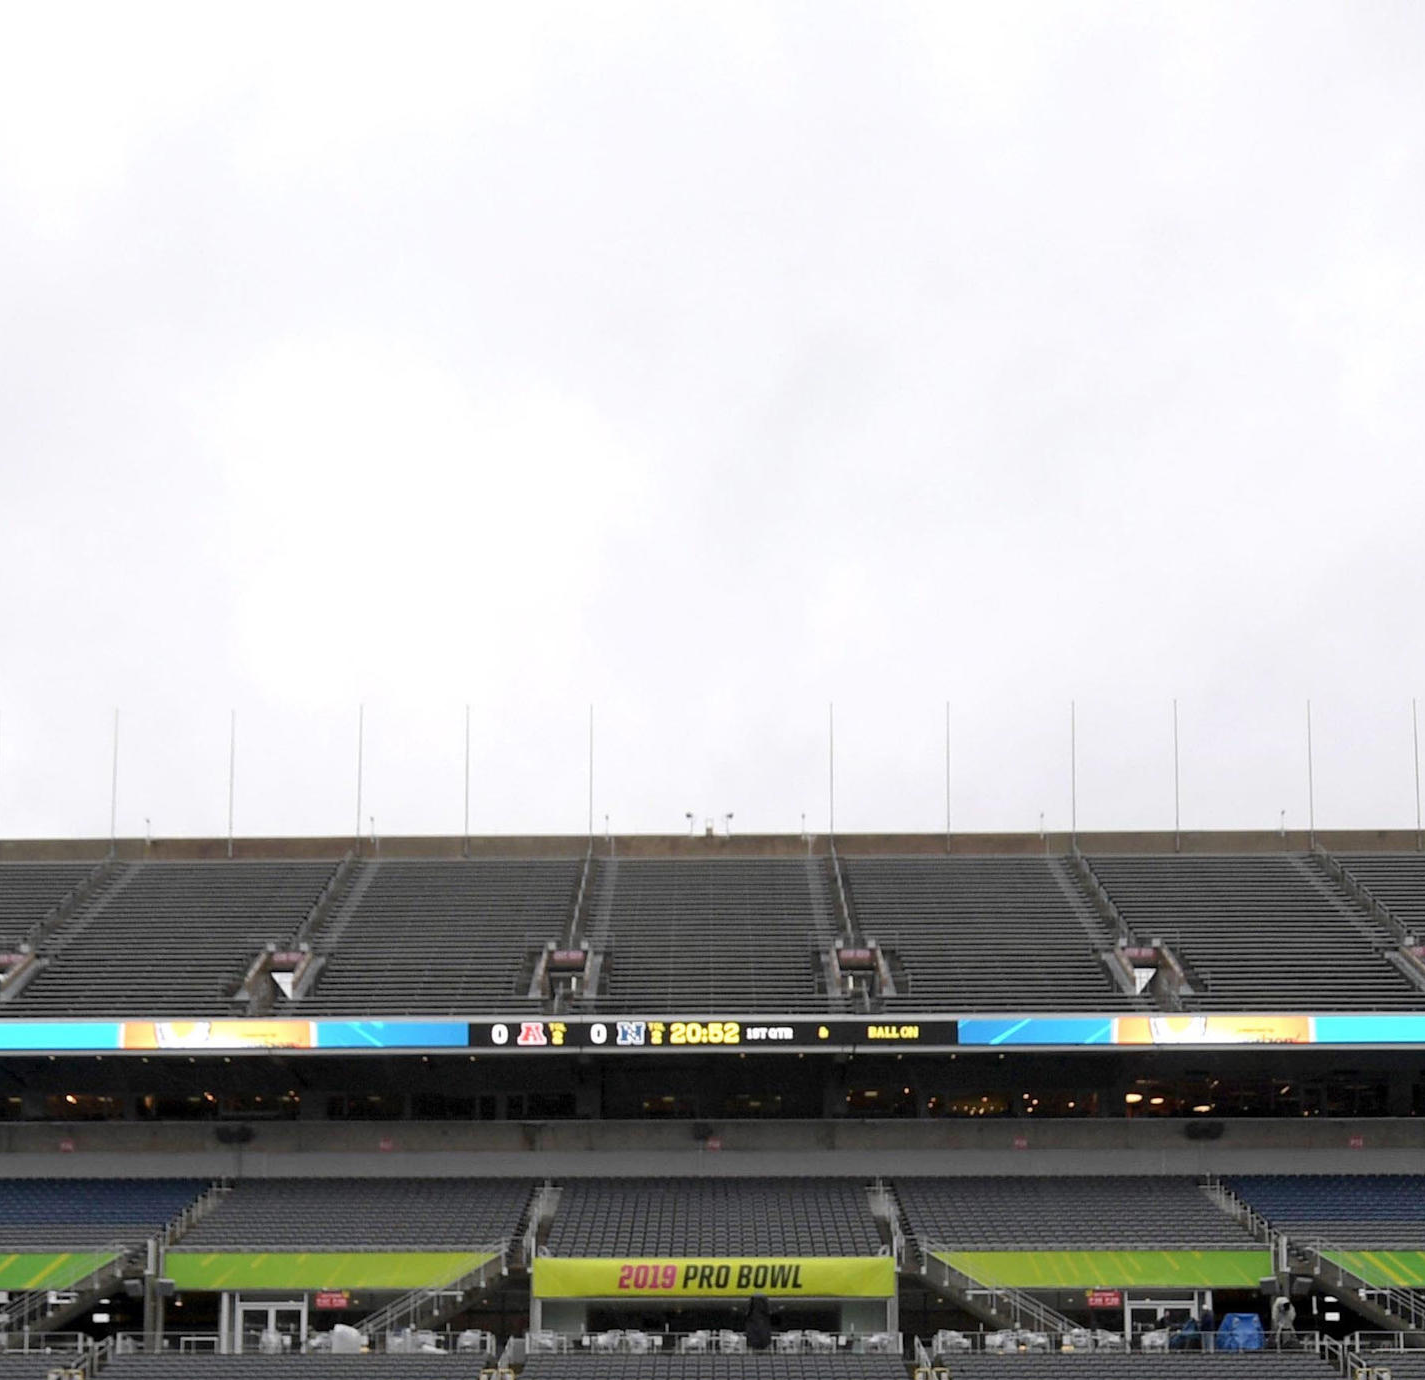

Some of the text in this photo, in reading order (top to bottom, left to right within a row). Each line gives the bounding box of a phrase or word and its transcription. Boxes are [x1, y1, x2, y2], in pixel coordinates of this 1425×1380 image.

[491, 1023, 509, 1045] 0
[590, 1023, 607, 1044] 0
[669, 1023, 740, 1045] 20:52
[867, 1026, 919, 1039] BALL ON
[618, 1264, 803, 1289] 2019 PRO BOWL
